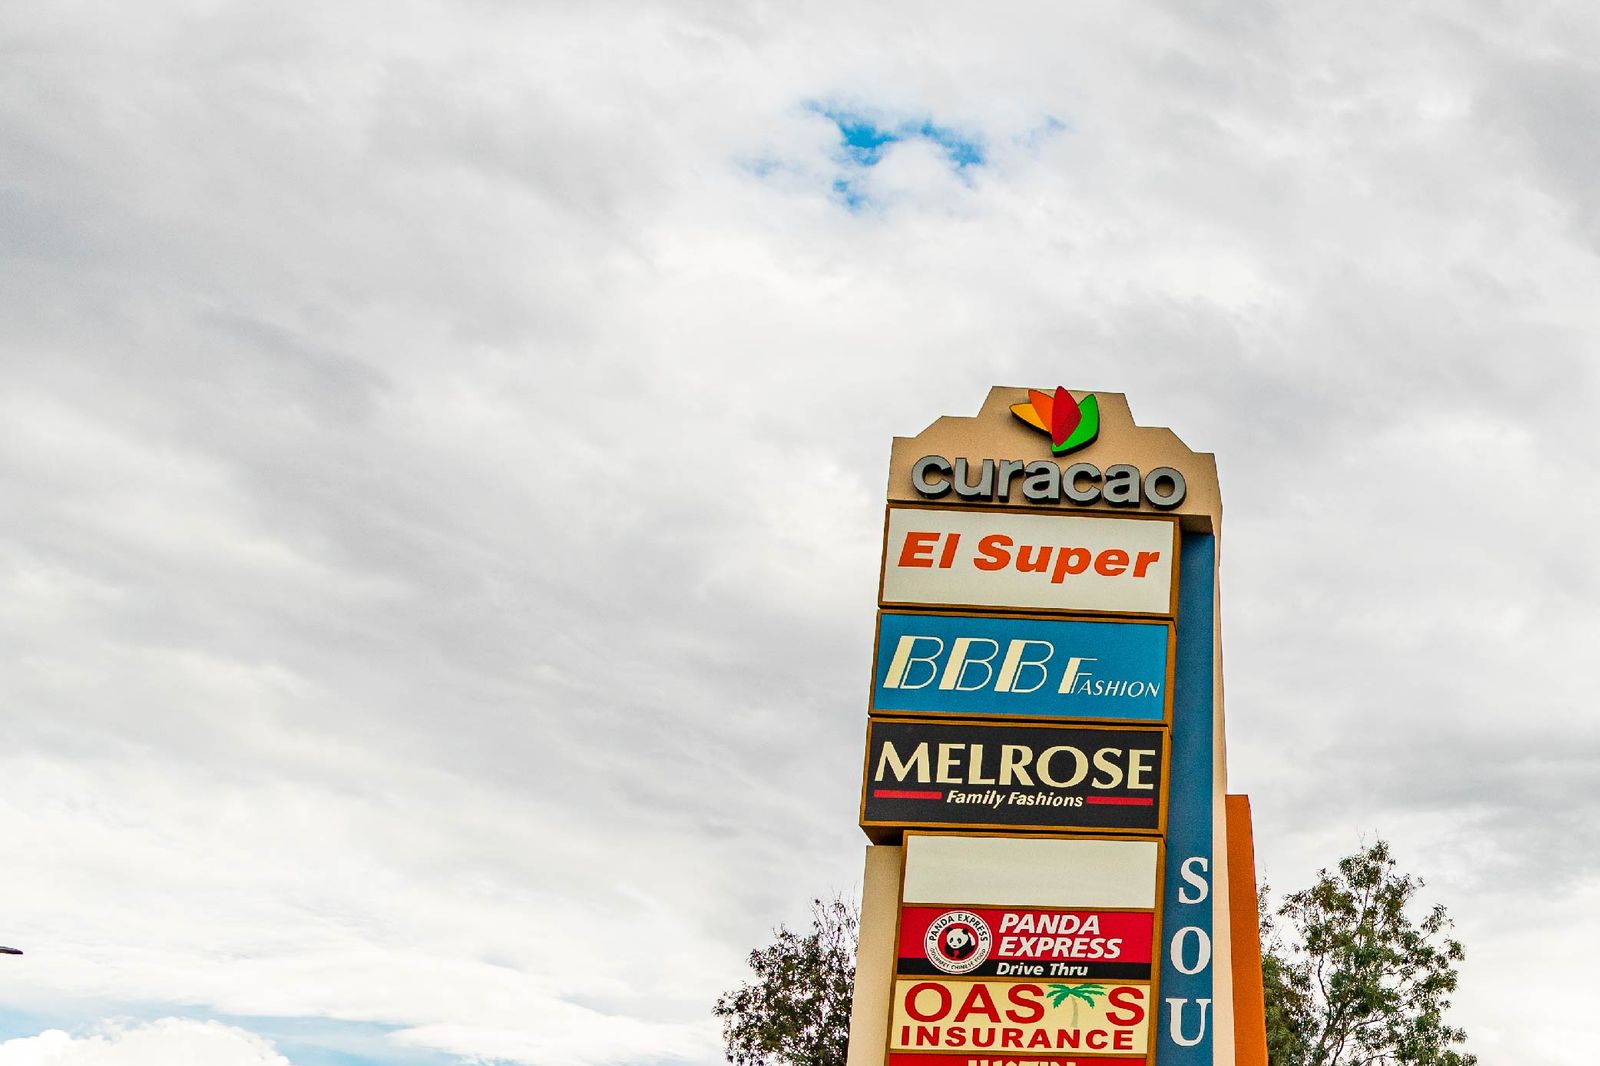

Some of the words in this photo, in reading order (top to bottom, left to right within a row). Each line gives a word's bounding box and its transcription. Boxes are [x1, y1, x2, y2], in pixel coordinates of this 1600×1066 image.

[911, 454, 1187, 511] curacao
[898, 531, 961, 569] El
[973, 534, 1161, 584] Super
[882, 635, 1055, 694] BBB
[874, 741, 1156, 790] MELROSE
[946, 789, 1004, 808] Family
[1008, 791, 1084, 808] Fashions
[929, 915, 955, 941] PANDA
[957, 914, 988, 941] EXPRESS
[999, 913, 1100, 935] PANDA
[998, 936, 1122, 959] EXPRESS
[996, 962, 1044, 976] Drive
[1050, 963, 1088, 976] Thru
[901, 1025, 1134, 1050] INSURANCE
